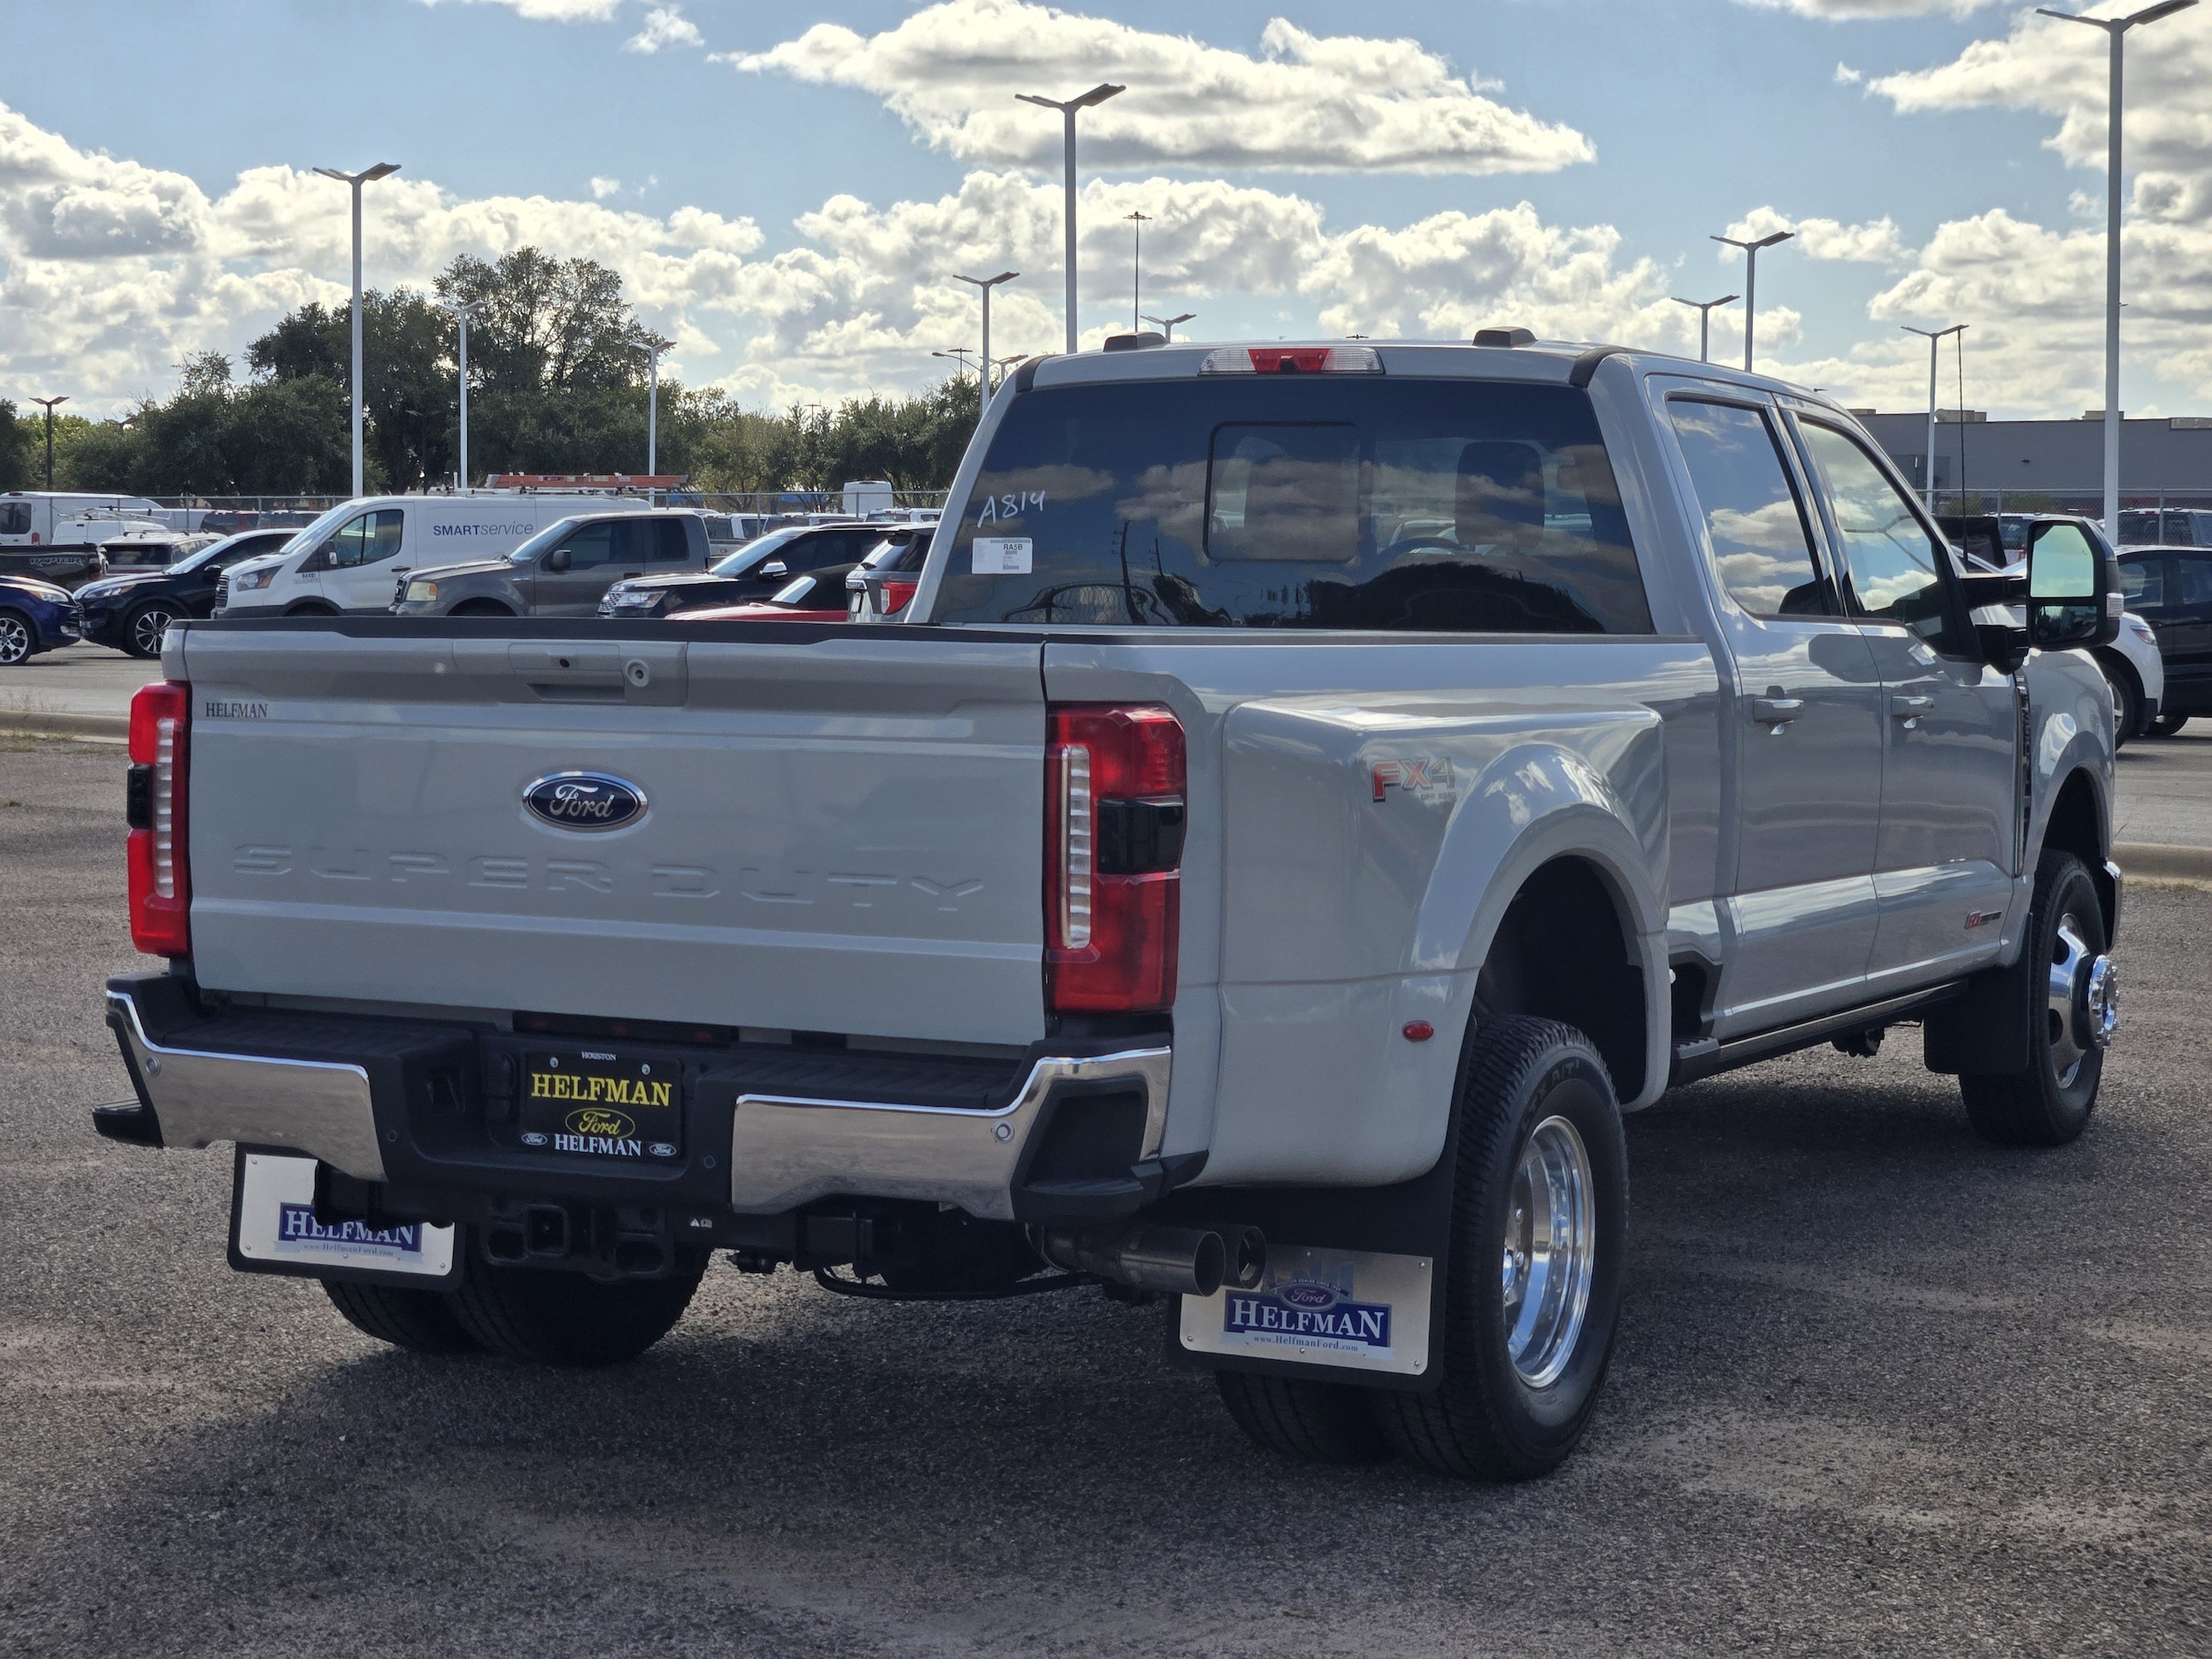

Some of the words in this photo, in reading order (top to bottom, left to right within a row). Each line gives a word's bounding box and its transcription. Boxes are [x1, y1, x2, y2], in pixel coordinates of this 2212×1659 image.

[977, 490, 1045, 528] A814
[205, 702, 268, 718] HELFMAN
[1371, 757, 1455, 803] FX4
[549, 783, 615, 818] Ford
[234, 842, 612, 894] SUPER
[650, 861, 984, 912] DUTY
[581, 1051, 617, 1061] HOUSTON
[531, 1073, 672, 1107] HELFMAN
[578, 1110, 620, 1135] Ford
[555, 1133, 641, 1156] HELFMAN
[1291, 1288, 1326, 1303] Ford
[1232, 1299, 1385, 1339] HELFMAN
[1254, 1335, 1358, 1351] www.HelfmanFord.com
